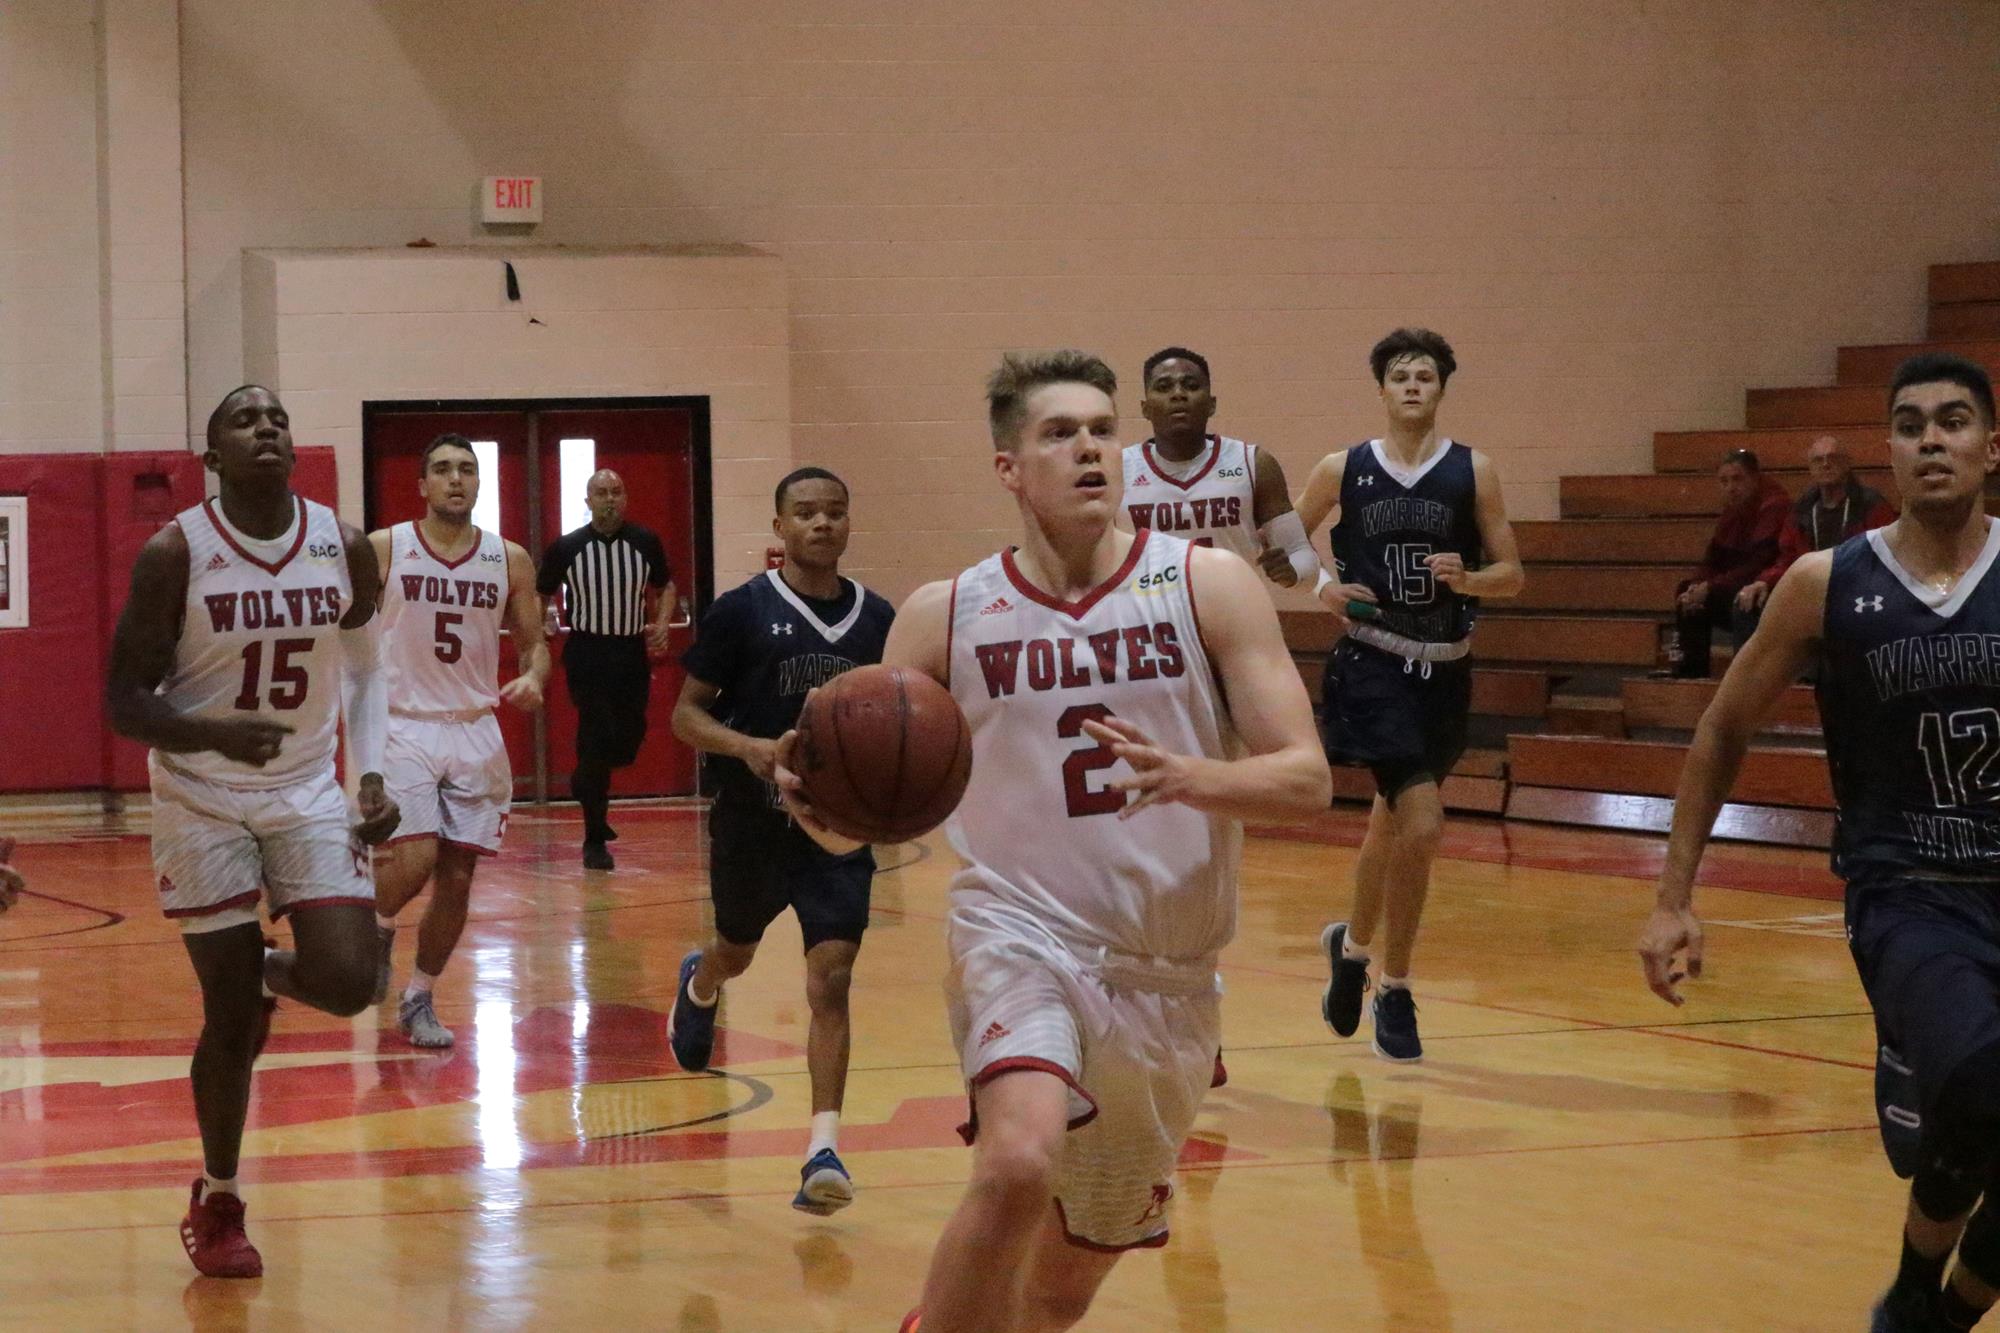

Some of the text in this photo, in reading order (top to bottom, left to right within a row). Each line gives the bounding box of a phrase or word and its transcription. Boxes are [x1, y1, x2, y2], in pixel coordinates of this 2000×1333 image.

[495, 179, 534, 209] EXIT
[1219, 467, 1244, 479] SAC
[1128, 496, 1241, 533] WOLVES
[1361, 497, 1454, 537] WARREN
[308, 544, 338, 558] SAC
[480, 553, 503, 563] SAC
[400, 574, 499, 610] WOLVES
[1138, 565, 1179, 590] SAC
[1384, 543, 1435, 605] 15
[204, 586, 342, 633] WOLVES
[434, 611, 463, 664] 5
[234, 637, 316, 711] 15
[974, 621, 1186, 699] WOLVES
[1056, 703, 1128, 818] 2
[1918, 707, 2000, 809] 12
